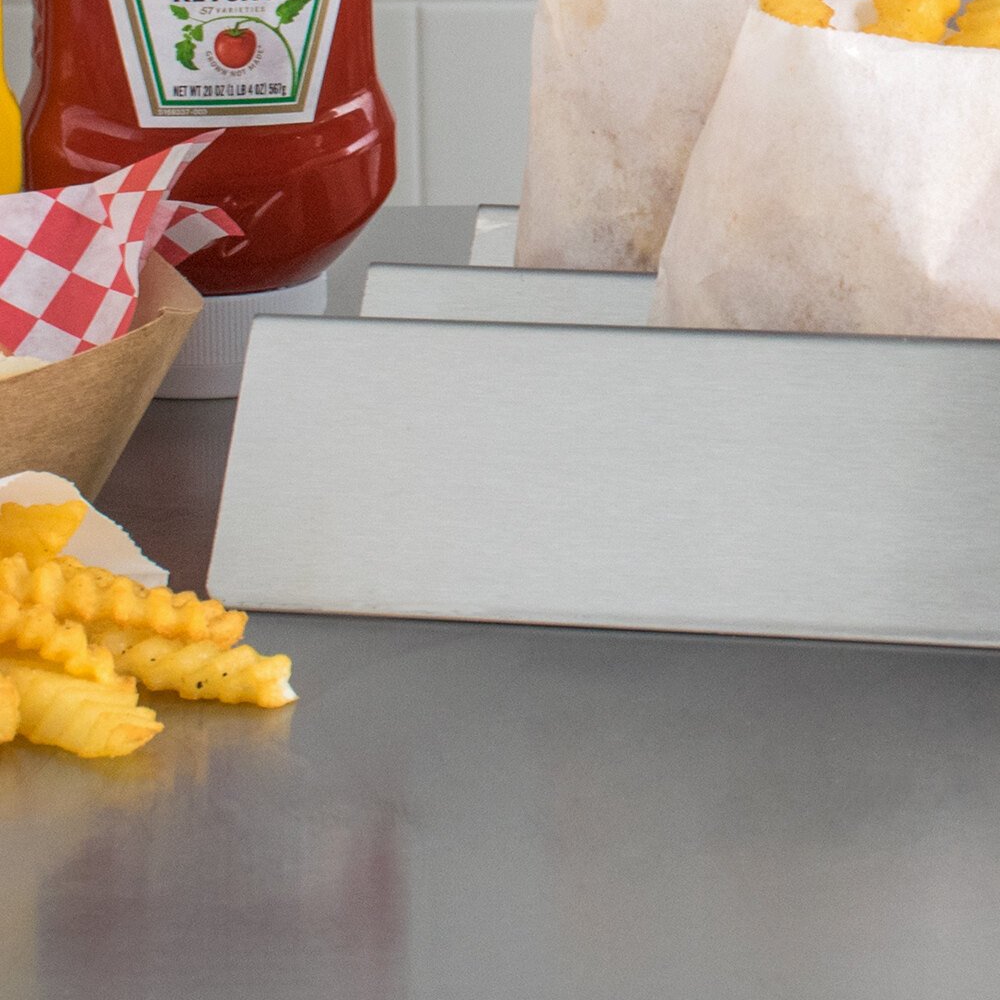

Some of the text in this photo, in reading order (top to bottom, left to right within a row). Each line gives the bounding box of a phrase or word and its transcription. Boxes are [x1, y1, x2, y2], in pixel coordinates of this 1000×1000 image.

[200, 6, 214, 15] 57
[206, 50, 228, 76] GROWN
[230, 68, 247, 77] NOT
[173, 85, 187, 97] NET
[190, 85, 201, 97] WT
[203, 85, 213, 97] 20
[215, 85, 226, 96] OZ
[237, 84, 246, 96] LB
[247, 84, 253, 95] 4
[269, 82, 287, 96] 567g
